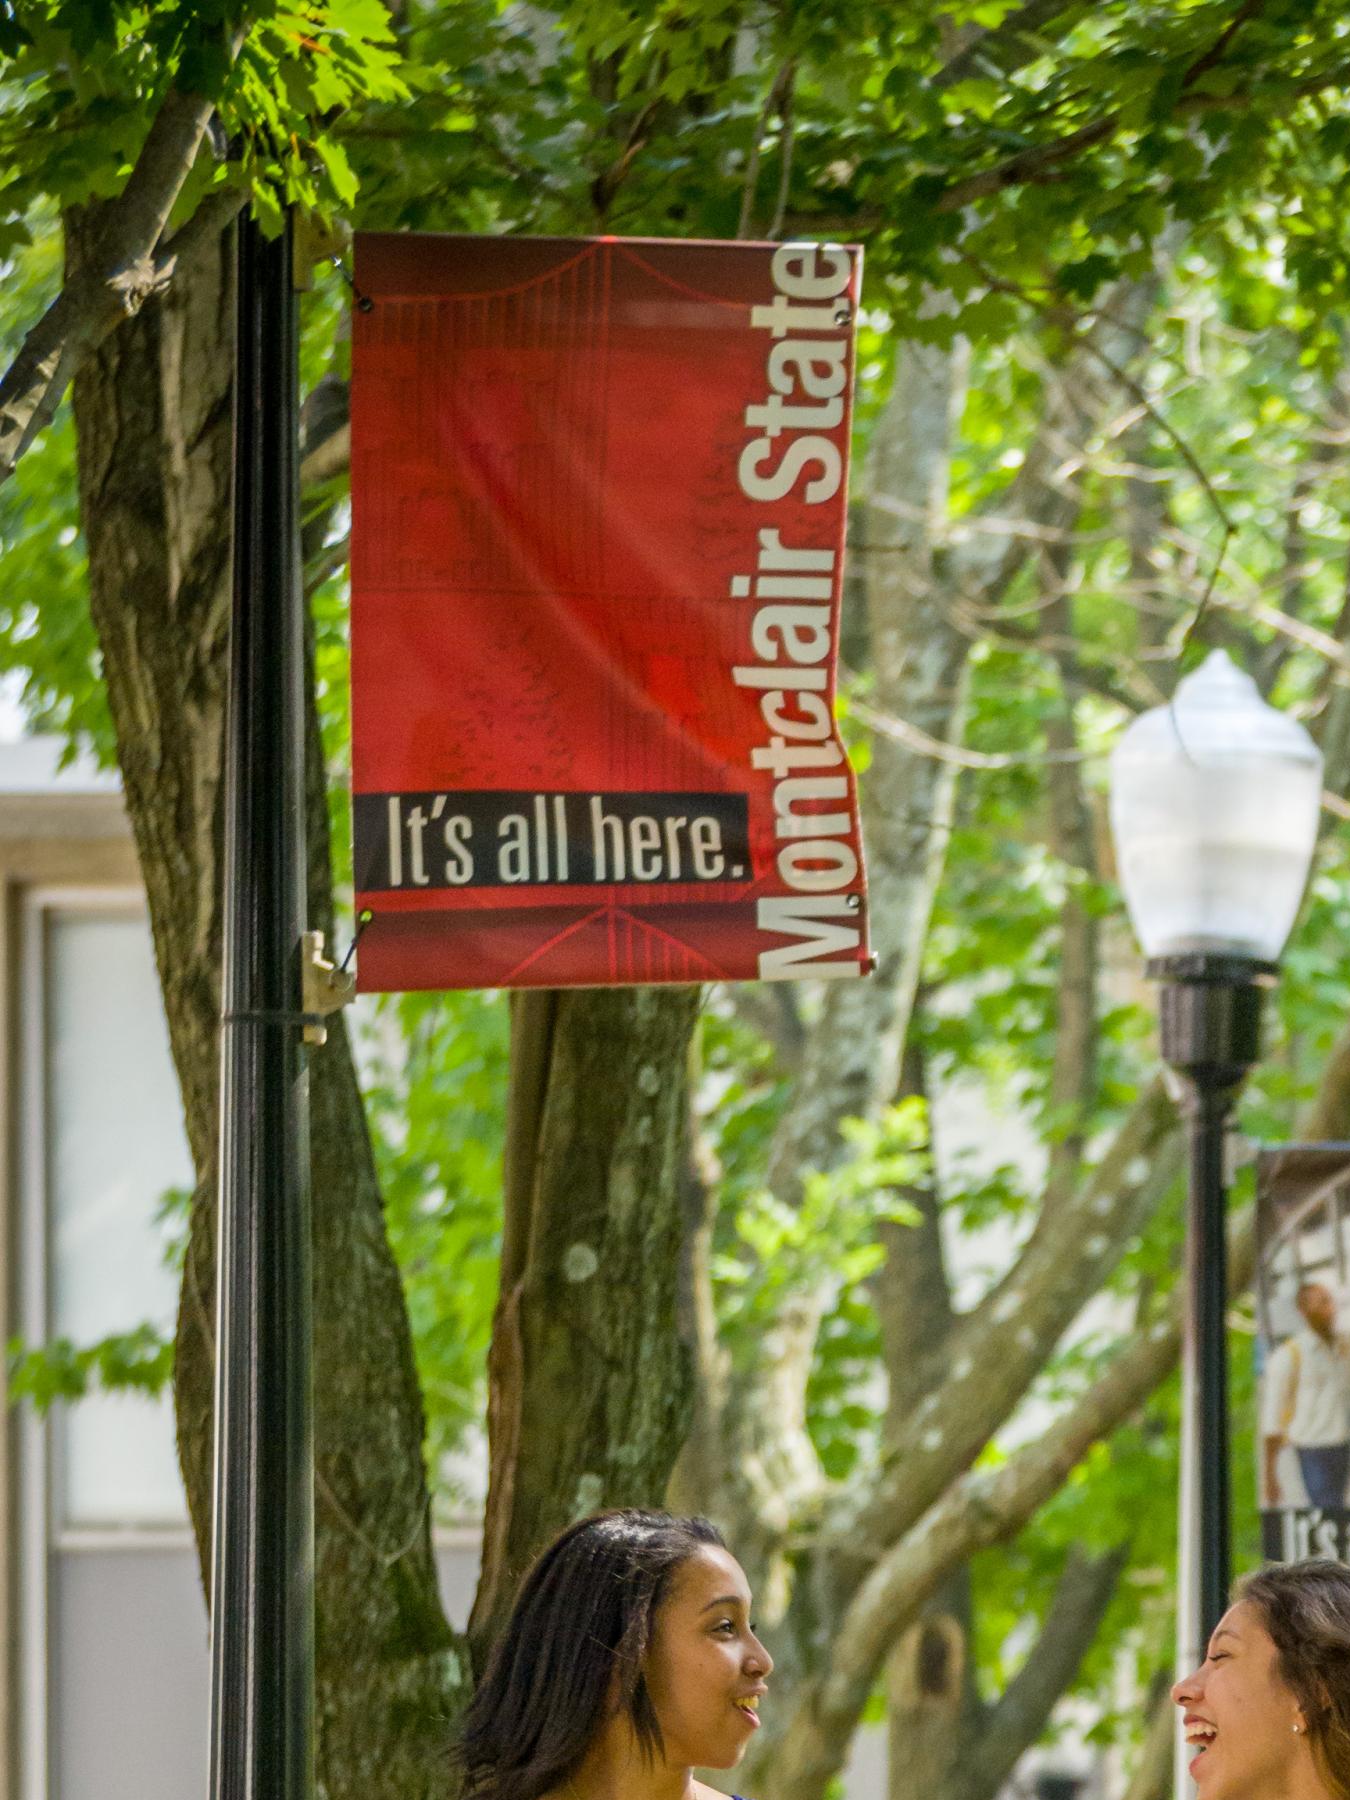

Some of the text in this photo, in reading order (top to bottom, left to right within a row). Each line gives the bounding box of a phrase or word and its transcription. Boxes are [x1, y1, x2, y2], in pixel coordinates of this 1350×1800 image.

[731, 242, 864, 981] Montclair State
[388, 794, 744, 887] It's all here.
[1282, 1508, 1339, 1564] It's
